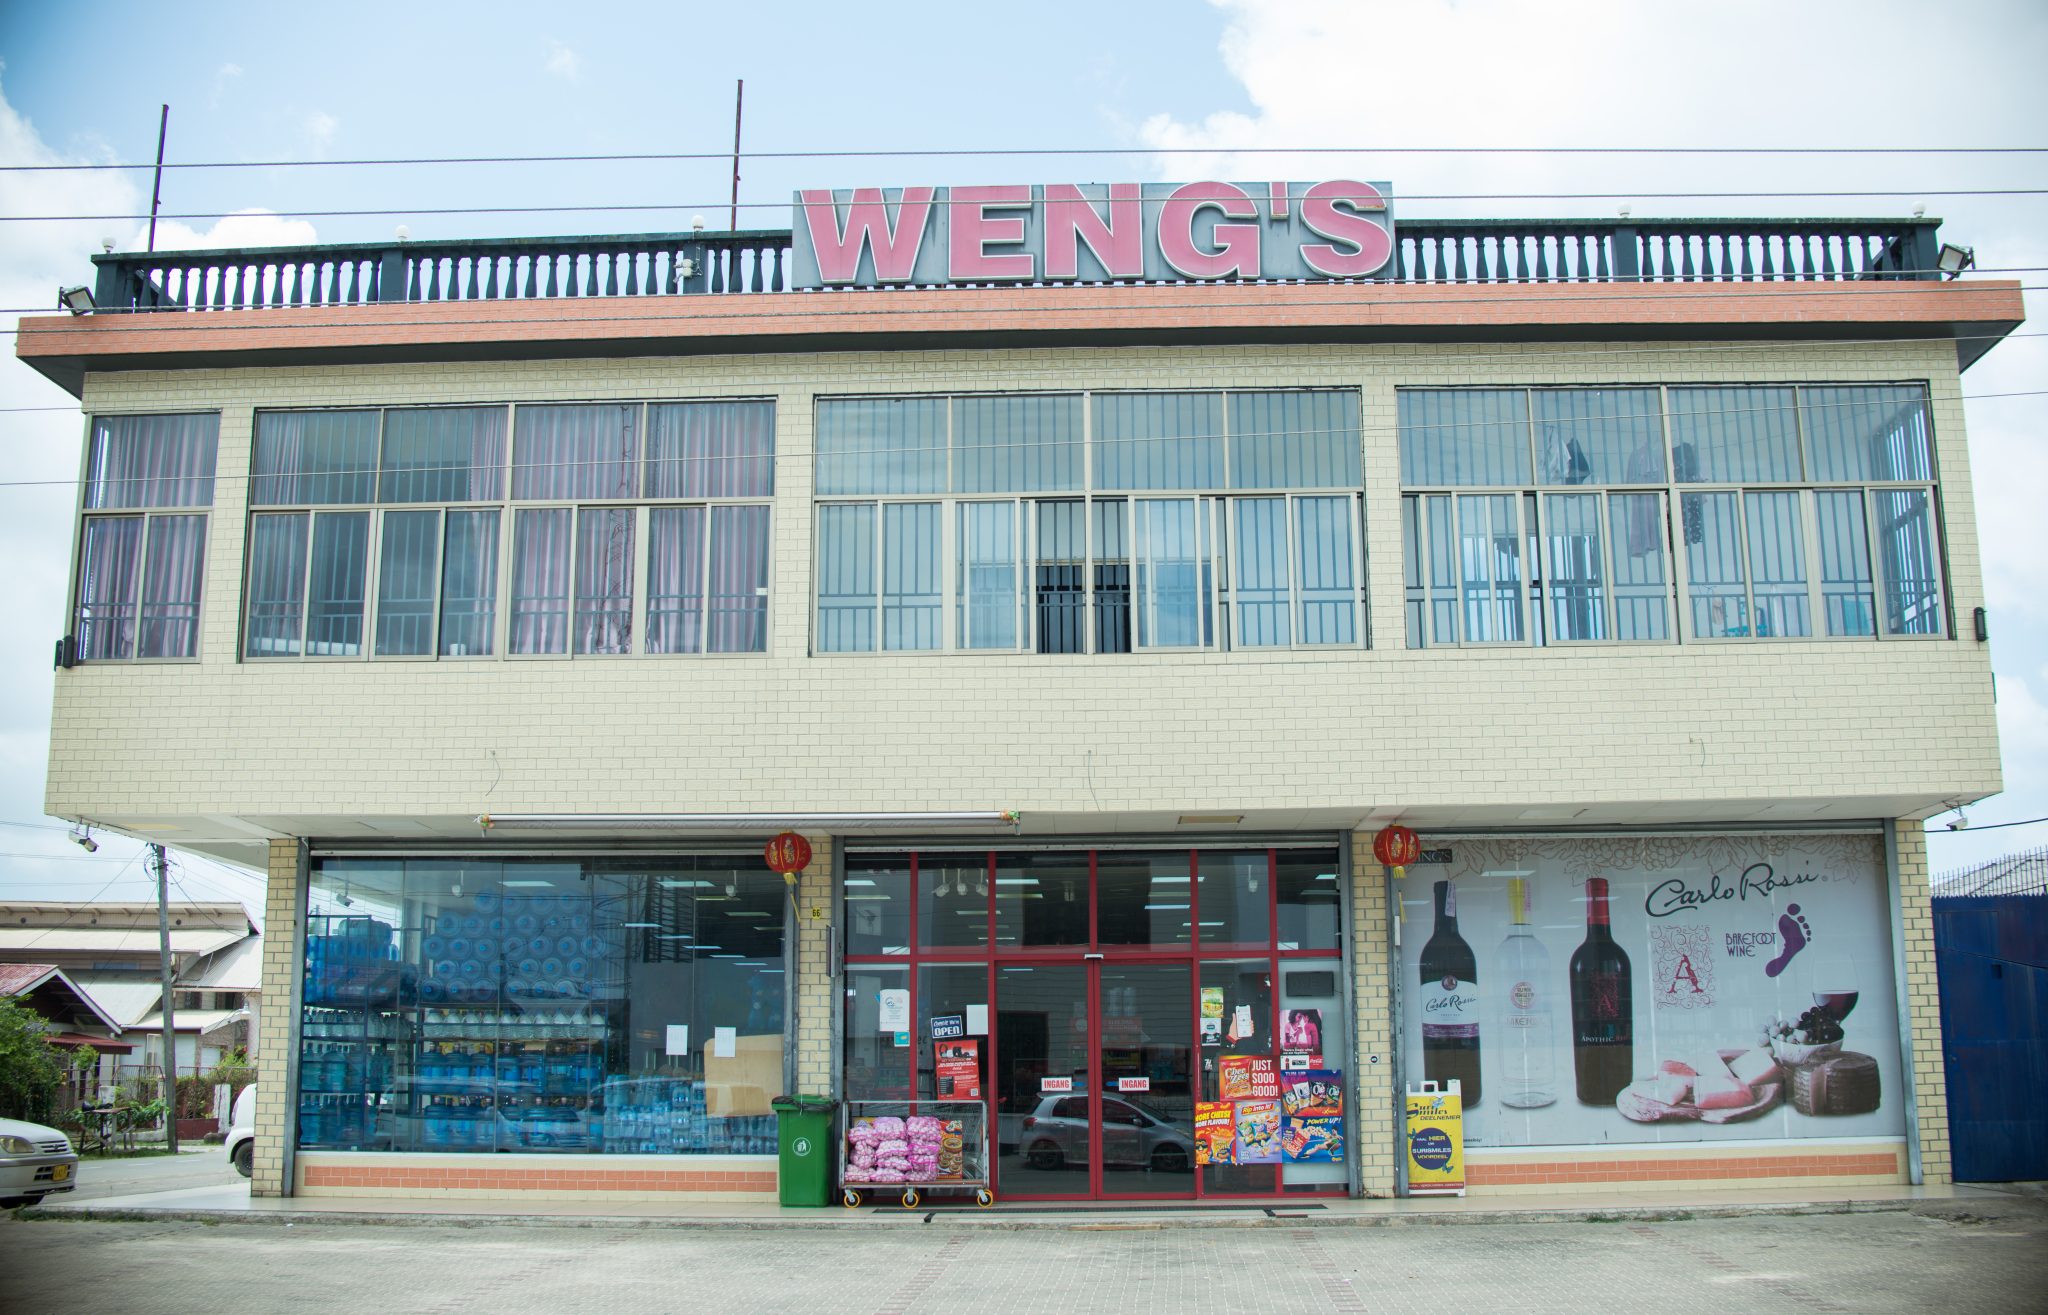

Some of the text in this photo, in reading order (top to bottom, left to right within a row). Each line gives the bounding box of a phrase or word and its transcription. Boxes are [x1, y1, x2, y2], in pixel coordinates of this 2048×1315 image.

[799, 179, 1392, 283] WENG'S
[1645, 860, 1819, 917] Carlo Rossi
[812, 909, 821, 917] 66
[1725, 932, 1777, 945] BAREFOOT
[1727, 945, 1757, 957] WINE
[1425, 994, 1477, 1012] Carlo Rossi
[934, 1025, 960, 1036] OPEN
[1252, 1060, 1272, 1071] JUST
[1252, 1072, 1275, 1083] SOOO
[1043, 1079, 1070, 1089] INGANG
[1121, 1079, 1147, 1089] INGANG
[1252, 1085, 1278, 1097] GOOD!
[1210, 1110, 1231, 1119] CHEESE
